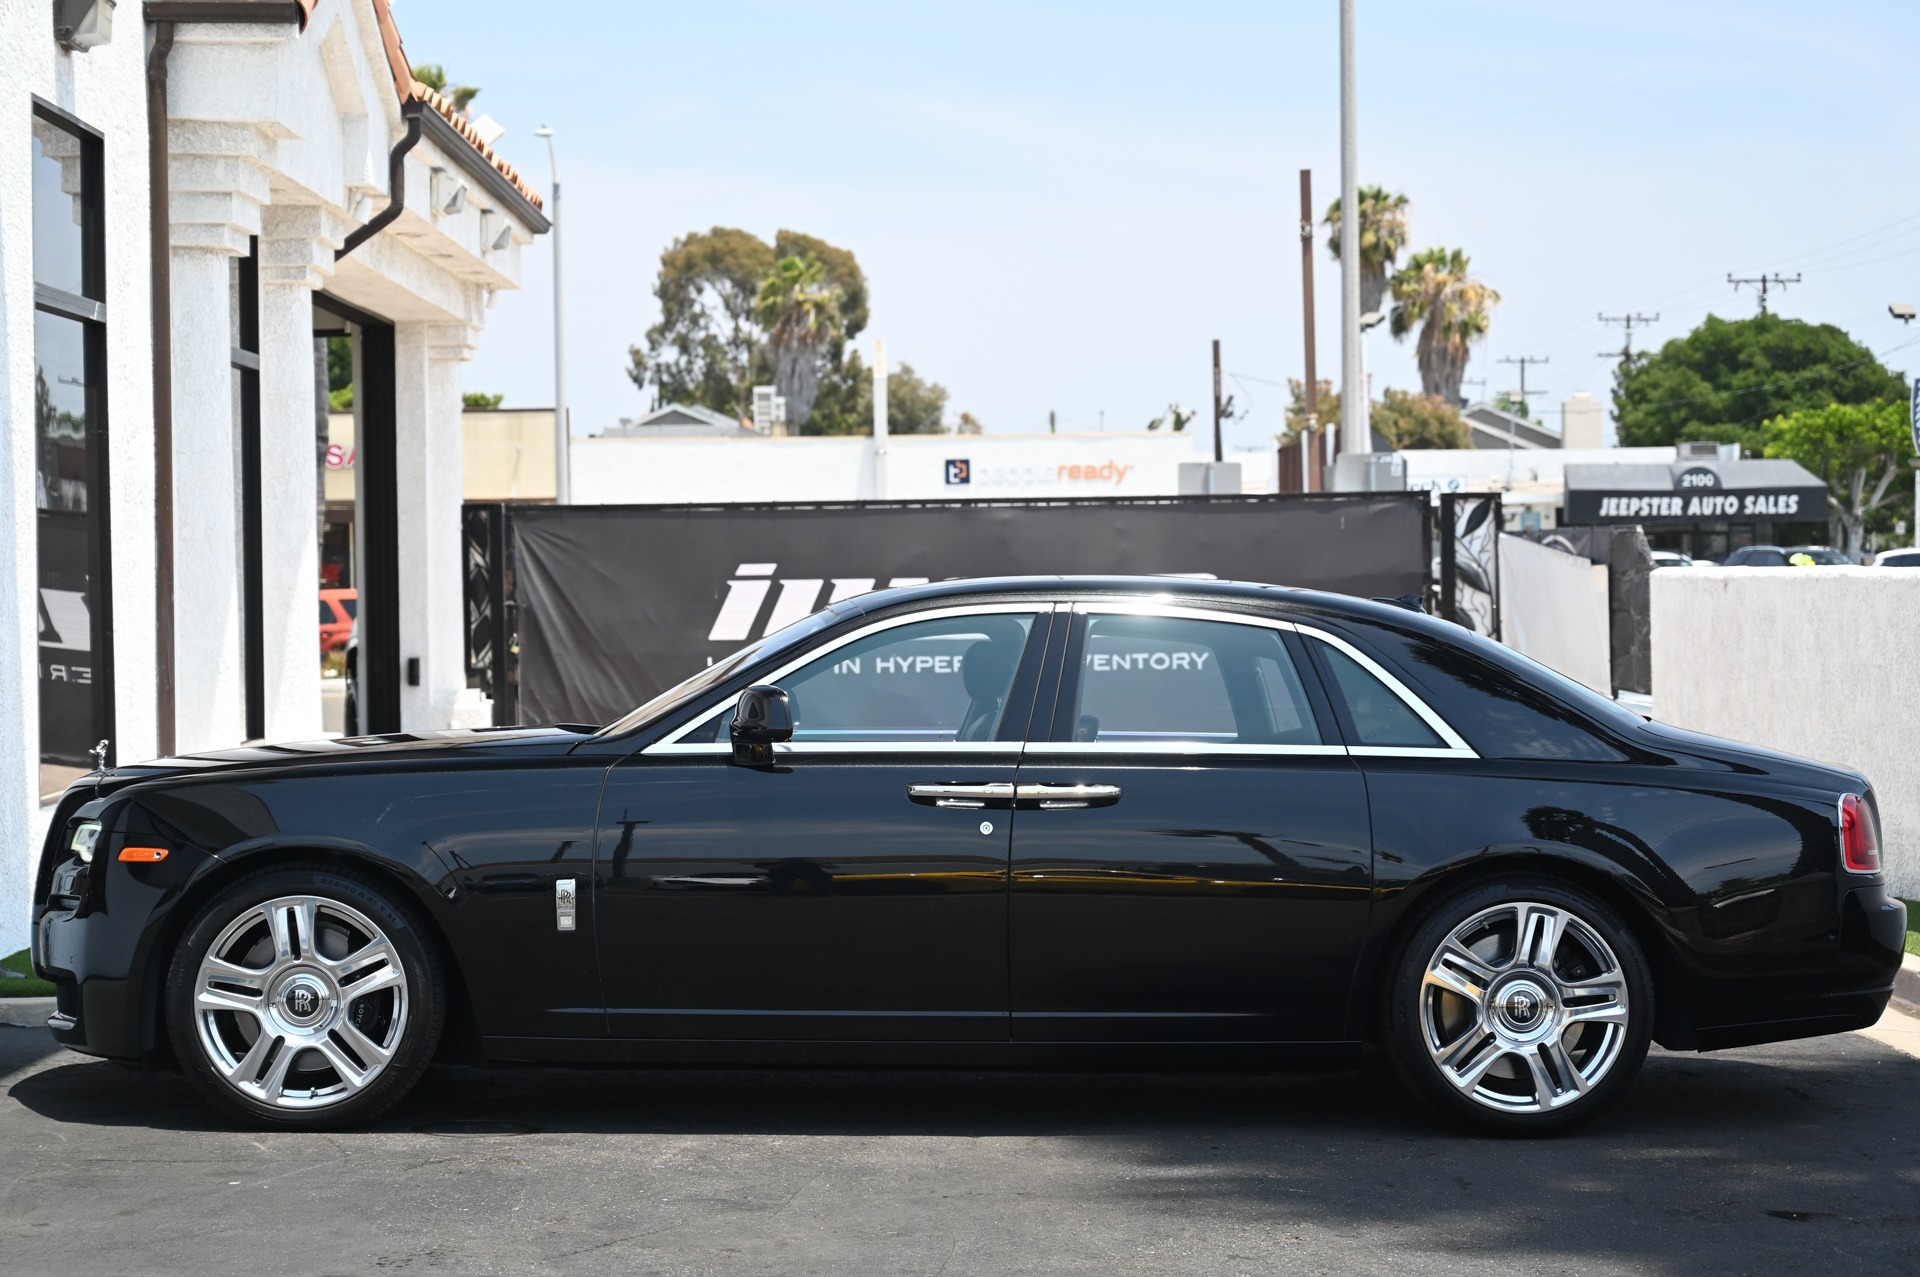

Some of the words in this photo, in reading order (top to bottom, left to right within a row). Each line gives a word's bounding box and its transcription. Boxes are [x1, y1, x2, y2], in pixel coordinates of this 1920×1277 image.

[1682, 473, 1715, 488] 2100
[1599, 496, 1684, 517] JEEPSTER
[1687, 495, 1739, 516] AUTO
[1744, 494, 1799, 515] SALES
